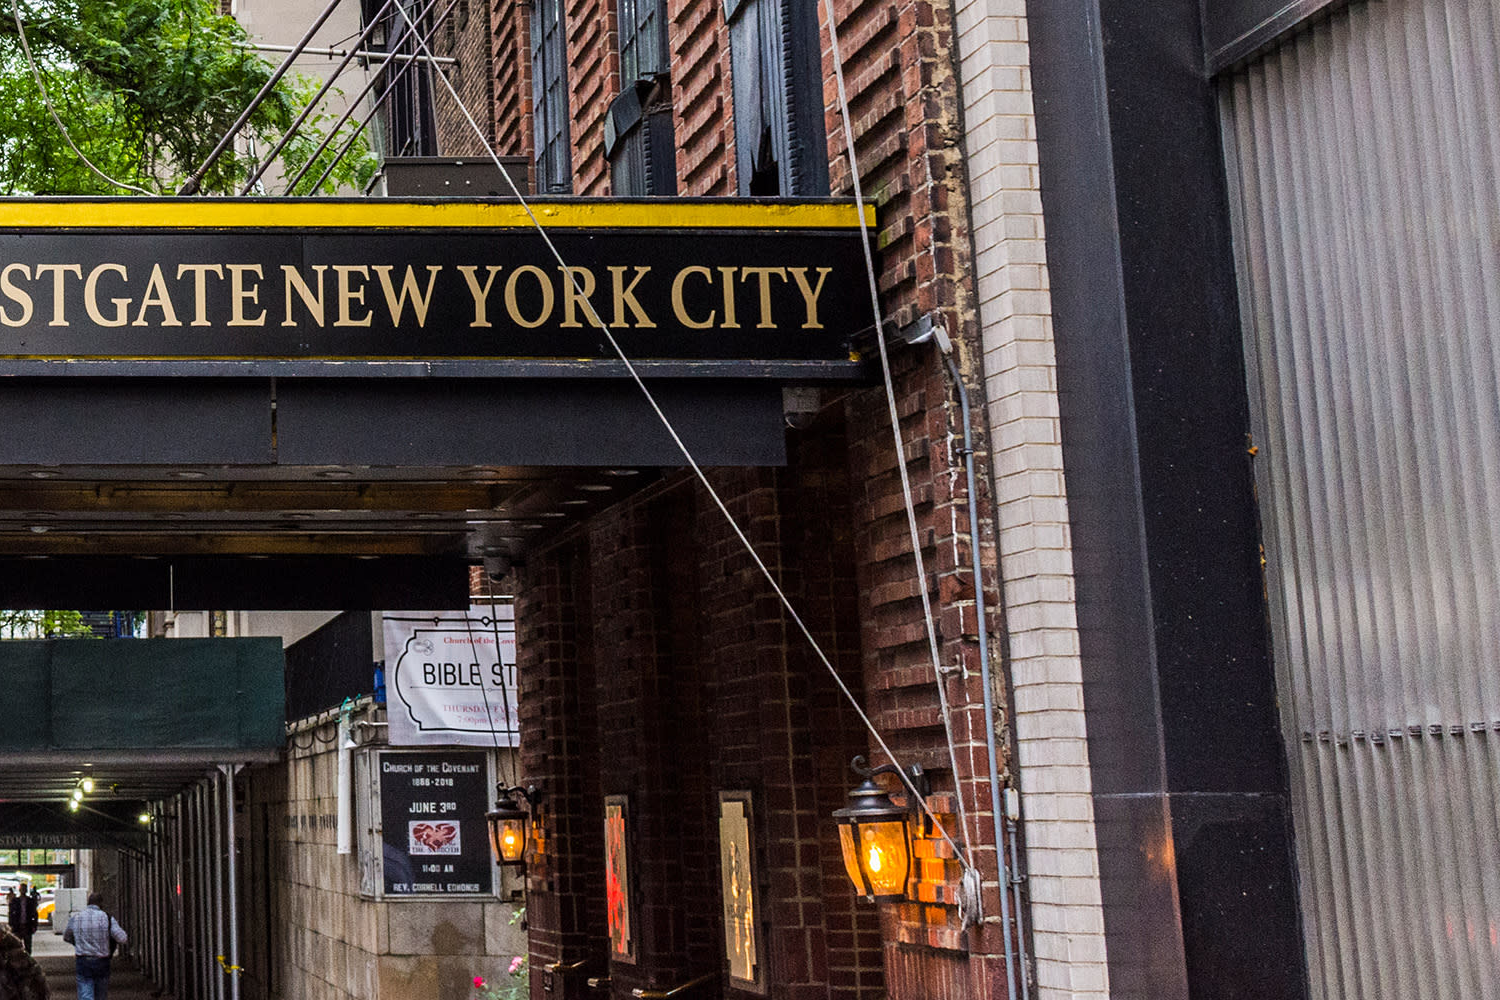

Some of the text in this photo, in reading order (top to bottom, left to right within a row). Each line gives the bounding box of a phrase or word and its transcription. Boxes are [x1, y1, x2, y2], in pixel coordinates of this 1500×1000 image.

[280, 264, 443, 328] NEW
[457, 264, 658, 329] YORK
[671, 265, 833, 329] CITY
[423, 663, 482, 686] BIBLE
[414, 764, 424, 773] OF
[426, 764, 440, 773] THE
[442, 762, 479, 773] COVENANT
[409, 802, 457, 814] JUNE 3RD
[444, 864, 454, 873] AM
[393, 883, 410, 892] REV.
